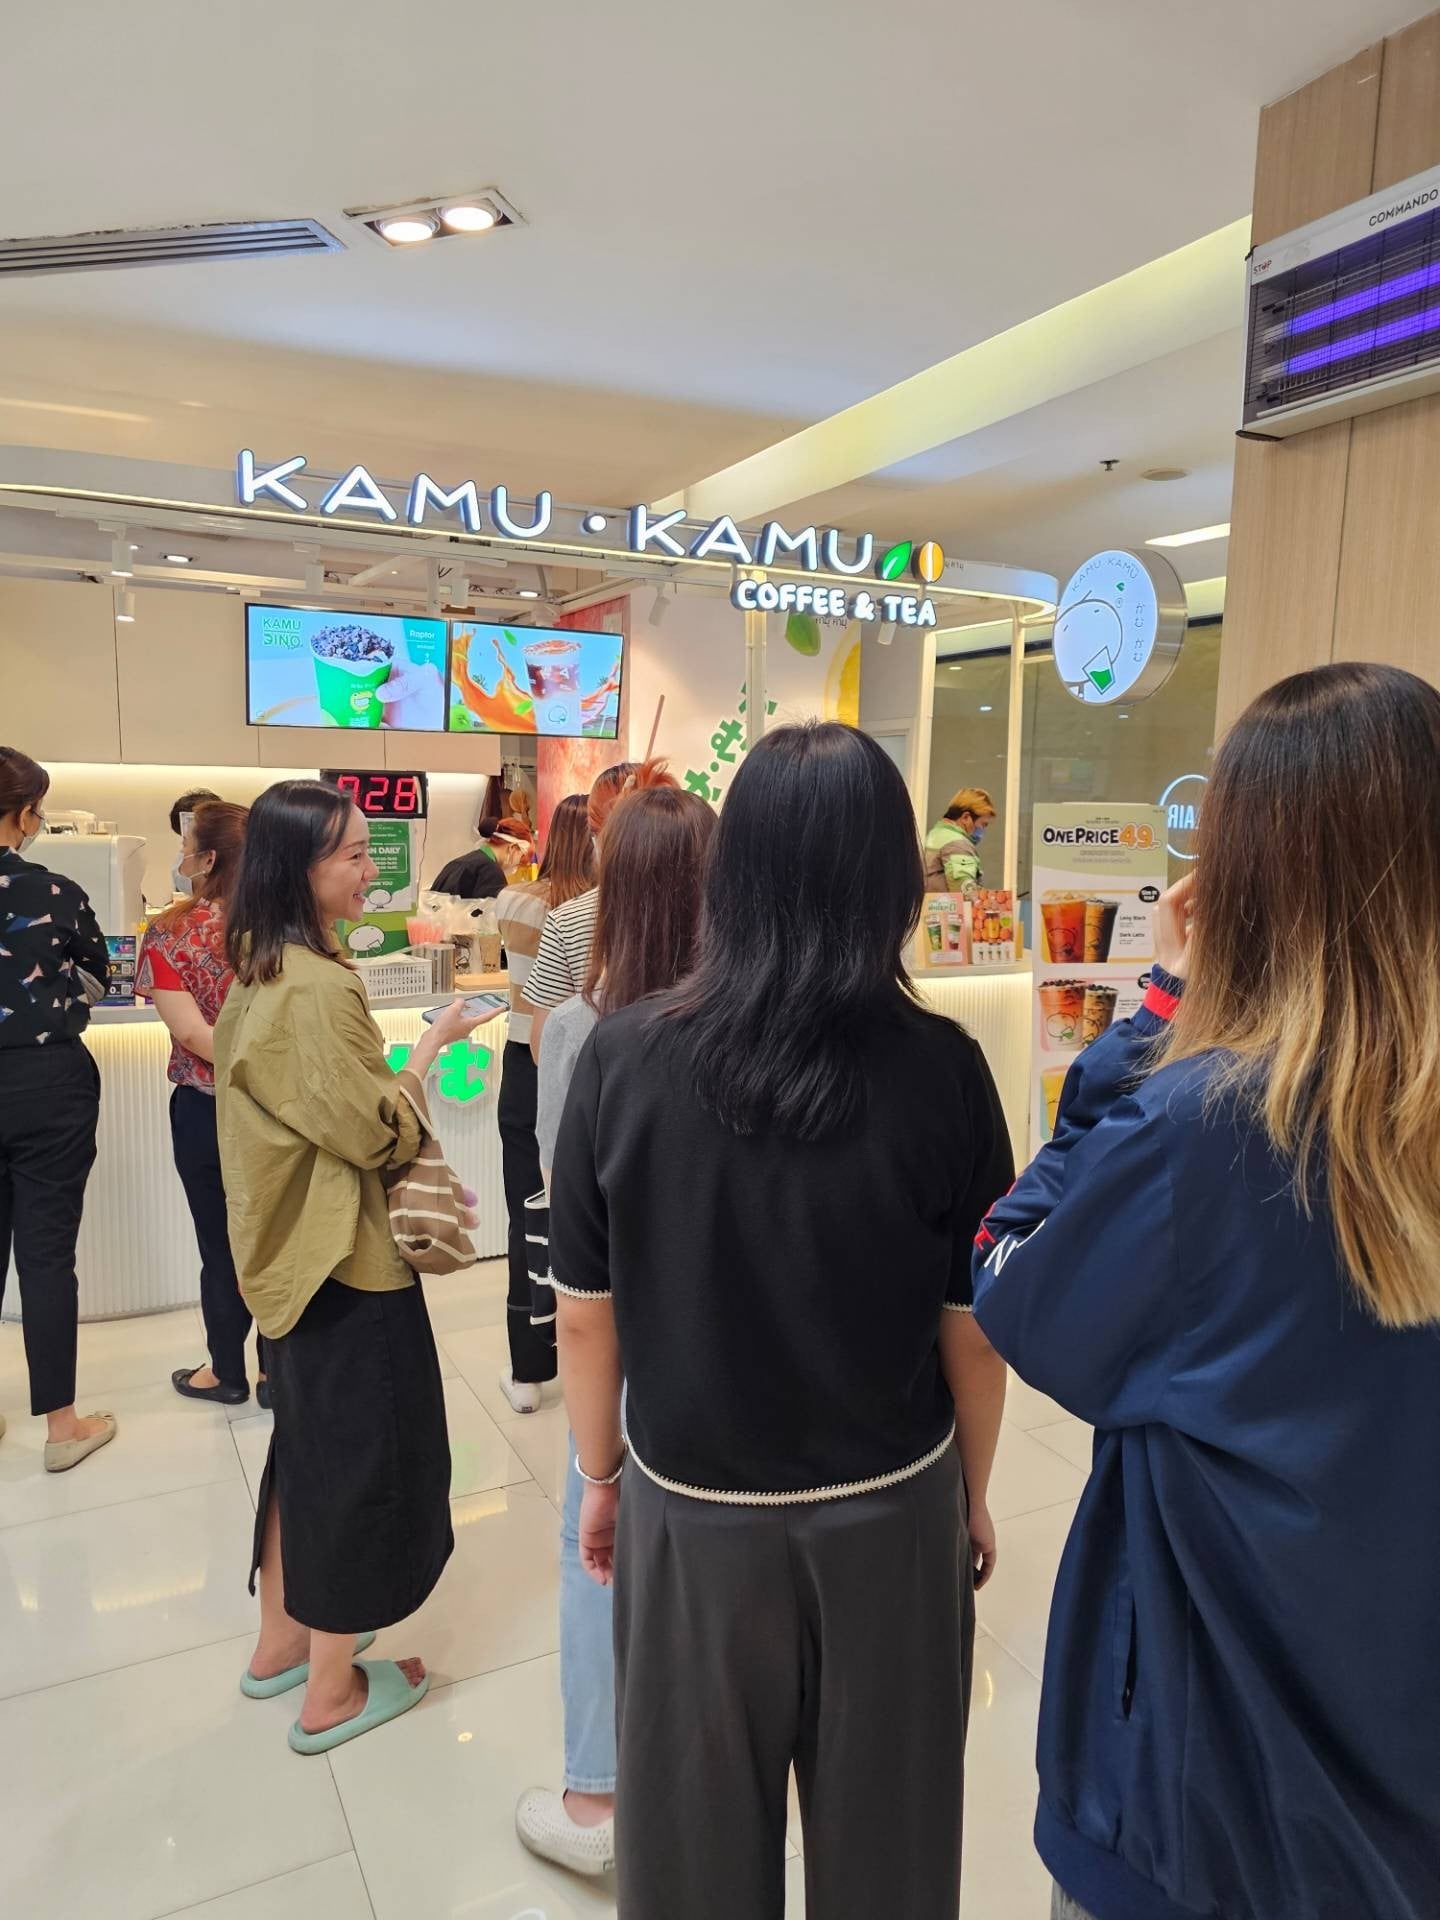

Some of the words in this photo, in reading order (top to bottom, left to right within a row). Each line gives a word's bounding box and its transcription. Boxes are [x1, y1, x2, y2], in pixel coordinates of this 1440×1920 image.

[1368, 188, 1439, 227] COMMANDO
[237, 448, 553, 539] KAMU
[627, 504, 874, 574] KAMU
[263, 617, 301, 631] KAMU
[731, 579, 847, 617] COFFEE
[850, 590, 876, 621] &
[881, 594, 937, 627] TEA
